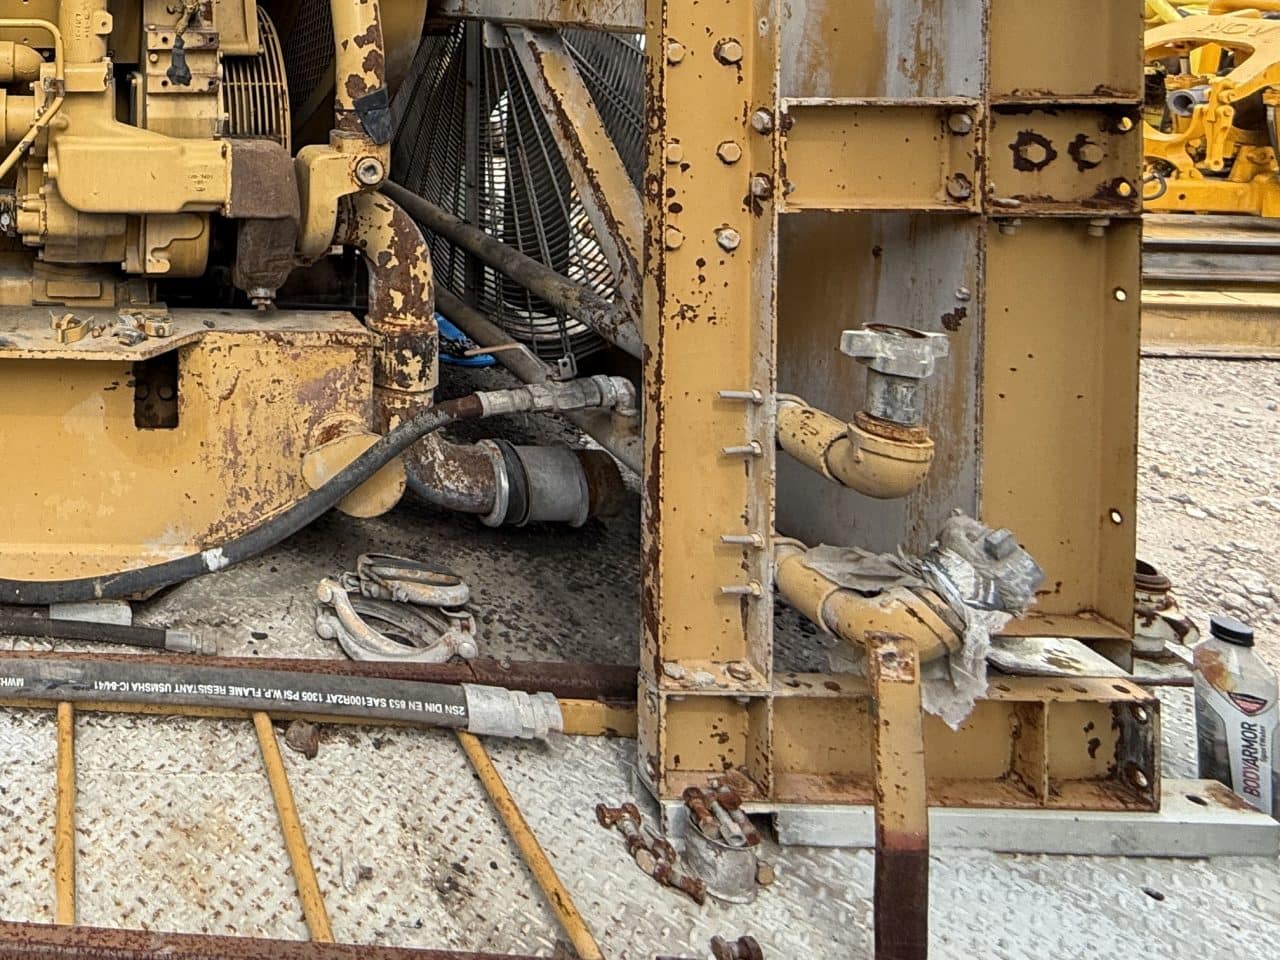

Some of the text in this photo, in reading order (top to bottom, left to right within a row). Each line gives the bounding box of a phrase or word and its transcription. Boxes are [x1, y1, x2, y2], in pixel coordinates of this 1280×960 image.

[131, 681, 171, 693] USMSHA
[174, 683, 226, 695] RESISTANT
[228, 685, 261, 697] FLAME
[301, 691, 323, 702] 1305
[326, 694, 387, 707] SAE100R2AT
[389, 699, 406, 709] 853
[409, 701, 423, 711] EN
[425, 702, 442, 714] DIN
[445, 704, 465, 716] 2SN
[1241, 721, 1260, 797] BODYARMOR
